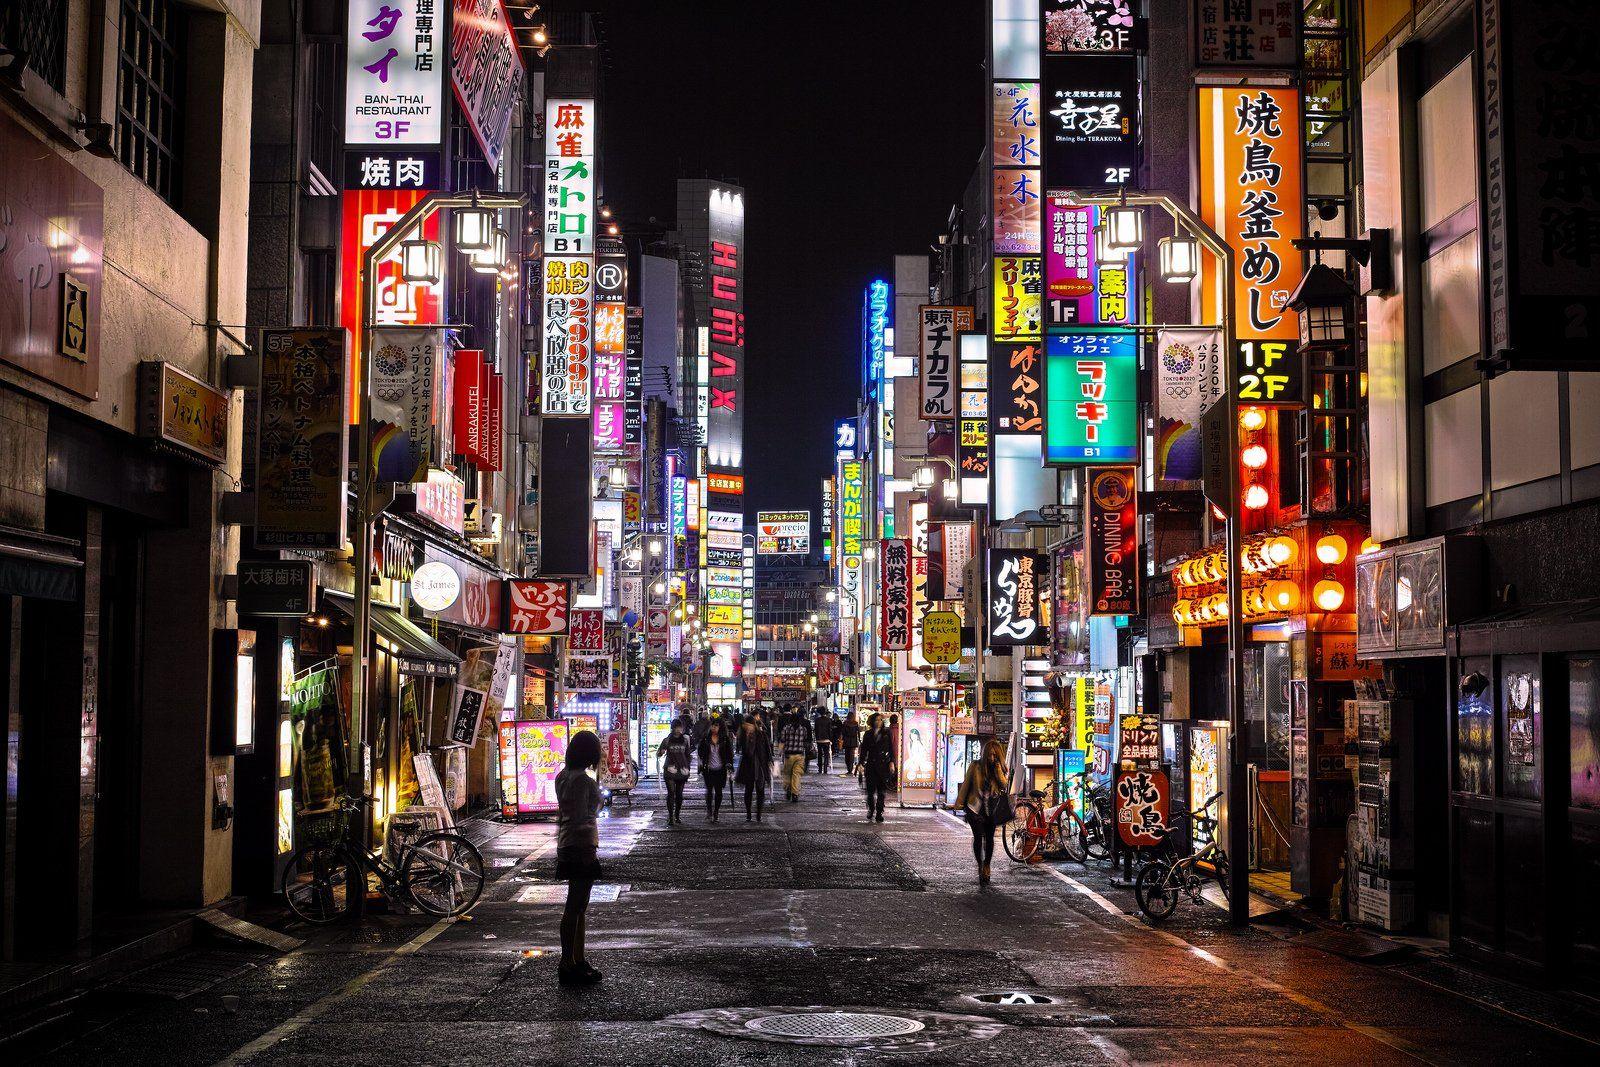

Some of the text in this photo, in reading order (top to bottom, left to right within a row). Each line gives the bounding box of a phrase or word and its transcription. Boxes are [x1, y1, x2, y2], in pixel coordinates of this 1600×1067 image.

[362, 6, 403, 83] タイ
[1101, 29, 1129, 50] 3F
[355, 106, 432, 116] RESTAURANT
[364, 95, 424, 104] BAN-THAI
[374, 120, 411, 139] 3F
[554, 103, 585, 157] 麻雀
[360, 157, 425, 187] 焼肉
[1104, 168, 1131, 183] 2F
[547, 160, 559, 234] 四名様専門店
[1235, 90, 1284, 332] 焼鳥釜めし
[1053, 211, 1064, 255] ホテル可
[1489, 157, 1504, 298] HONJIN
[554, 238, 583, 251] B1
[547, 261, 589, 279] 焼肉
[546, 278, 590, 295] ホルモン
[924, 310, 953, 325] 東京
[1050, 299, 1075, 323] 1F
[267, 335, 293, 351] 5F
[1058, 336, 1124, 344] オンライン
[1072, 345, 1111, 354] カフェ
[546, 297, 569, 413] 食べ放題の店
[926, 325, 952, 399] チカラ
[1240, 341, 1287, 367] 1F
[1210, 344, 1221, 397] 2020年
[1238, 375, 1290, 399] 2F
[924, 398, 953, 415] めし
[1075, 360, 1109, 443] ラッキー
[468, 386, 479, 450] ANRAKUTEI
[480, 396, 489, 460] ANRAKUTEI
[963, 421, 987, 433] 麻雀
[489, 408, 498, 469] ANRAKUTEI
[1084, 447, 1102, 457] B1
[822, 492, 832, 528] 北の家族
[843, 462, 862, 556] まんが喫茶
[1104, 512, 1123, 599] DINING BAR
[243, 569, 305, 586] 大塚歯科
[1017, 556, 1034, 618] 東京豚骨
[285, 598, 302, 610] 4F
[886, 544, 908, 646] 無料案内所
[1030, 740, 1041, 748] 1F
[1122, 730, 1158, 743] ドリンク
[1122, 744, 1158, 759] 全品半額
[1117, 771, 1166, 839] 焼鳥
